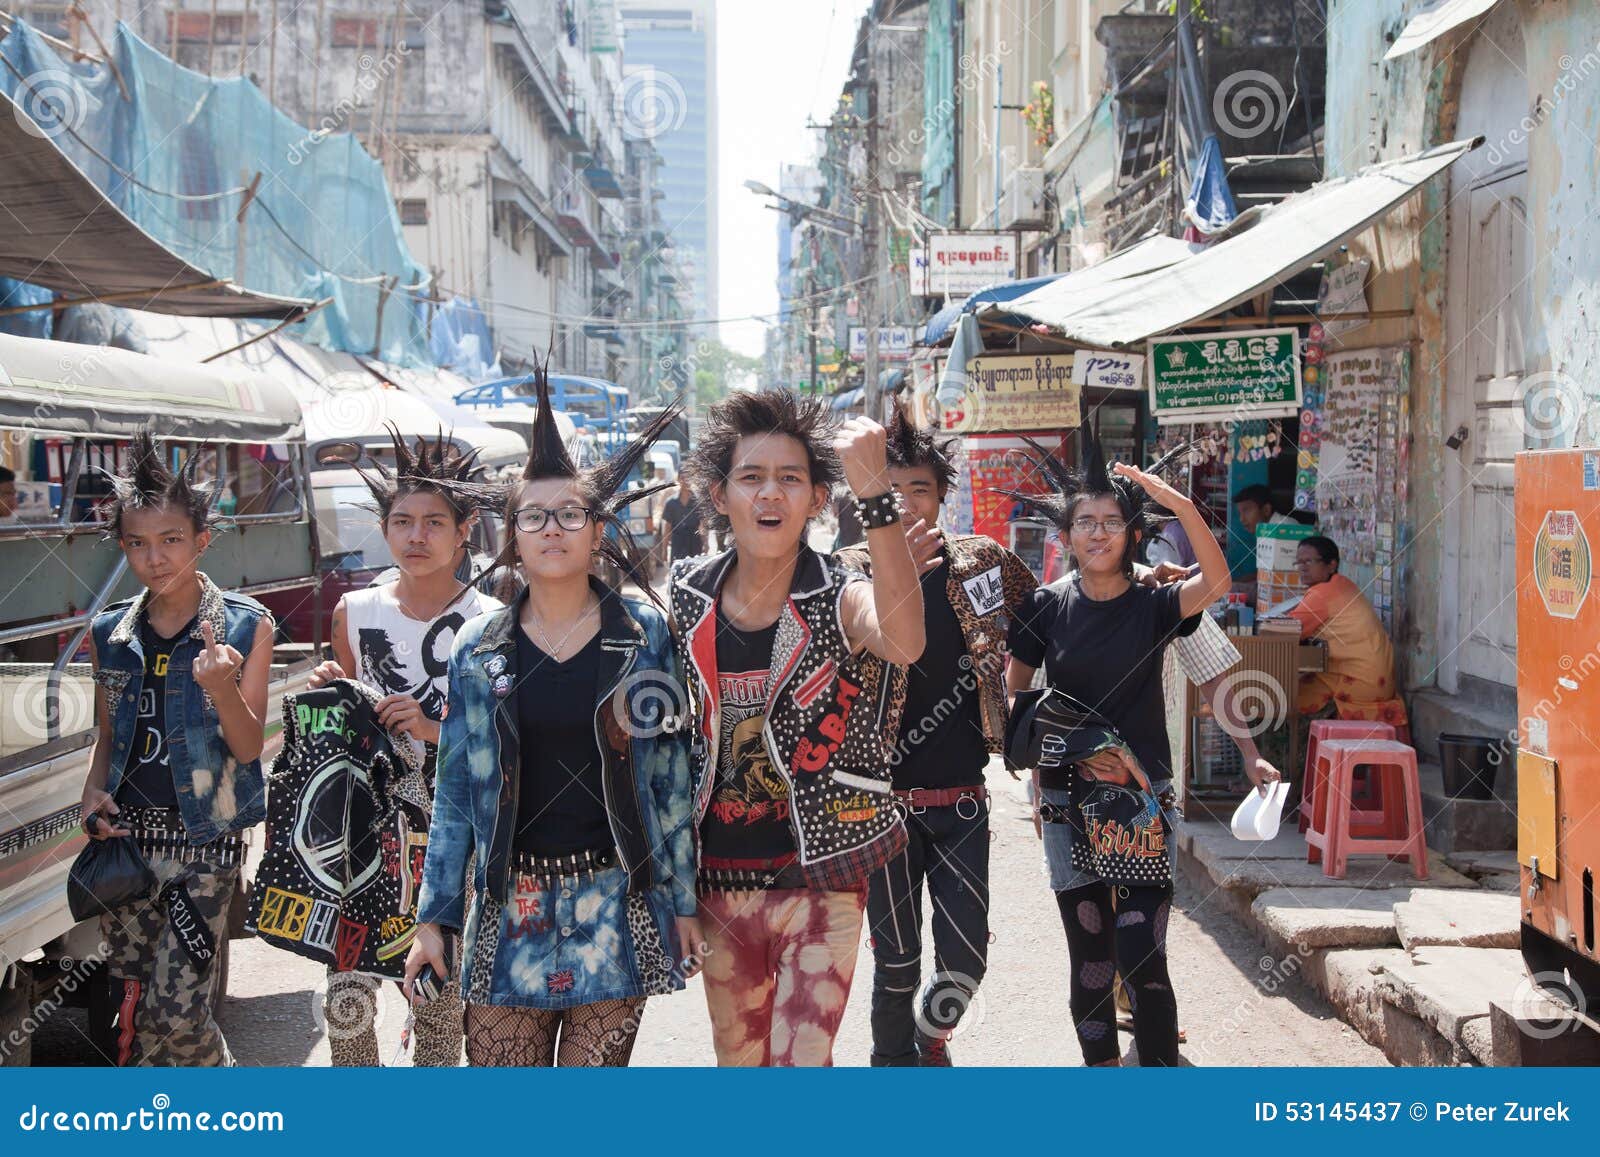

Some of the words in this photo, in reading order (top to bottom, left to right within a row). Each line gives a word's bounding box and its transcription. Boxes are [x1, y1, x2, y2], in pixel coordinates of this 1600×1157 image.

[1548, 588, 1575, 606] SILENT
[825, 794, 870, 814] LOWER
[169, 899, 213, 961] RULES
